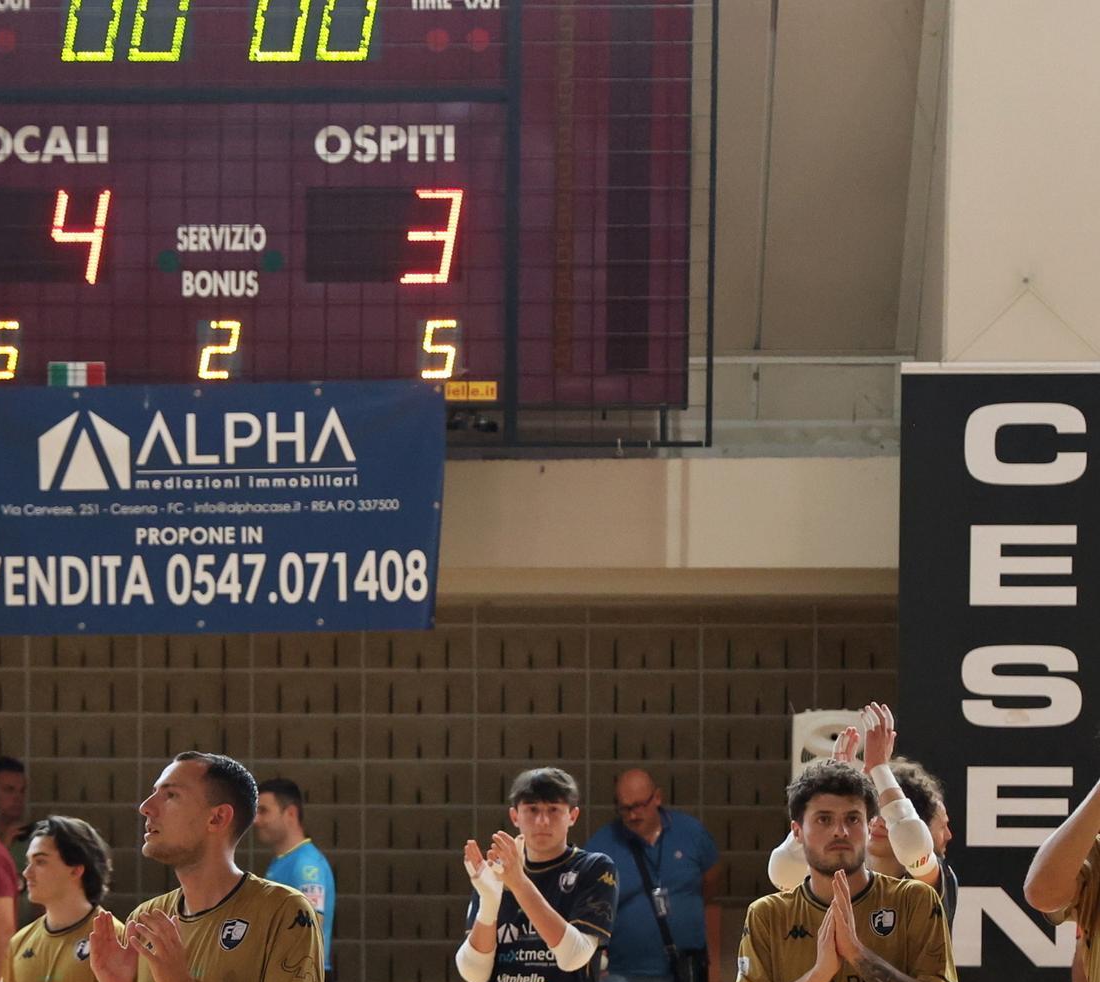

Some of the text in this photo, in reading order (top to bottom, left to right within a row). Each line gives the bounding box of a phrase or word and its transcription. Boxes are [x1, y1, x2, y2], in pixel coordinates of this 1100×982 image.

[313, 124, 456, 163] OSPITI
[51, 189, 111, 285] 4
[175, 223, 267, 252] SERVIZIO
[400, 188, 464, 284] 3
[181, 269, 259, 298] BONUS
[197, 319, 241, 380] 2
[419, 318, 458, 379] 5
[135, 406, 358, 467] ALPHA
[135, 473, 359, 490] mediazioni immobiliari
[1, 503, 21, 516] Via
[79, 502, 100, 516] 251
[110, 502, 158, 516] Cesena
[168, 501, 184, 515] FC
[311, 499, 335, 512] REA
[337, 499, 355, 512] FO
[357, 498, 401, 512] 337500
[135, 526, 264, 546] PROPONE IN
[165, 549, 429, 606] 0547.071408
